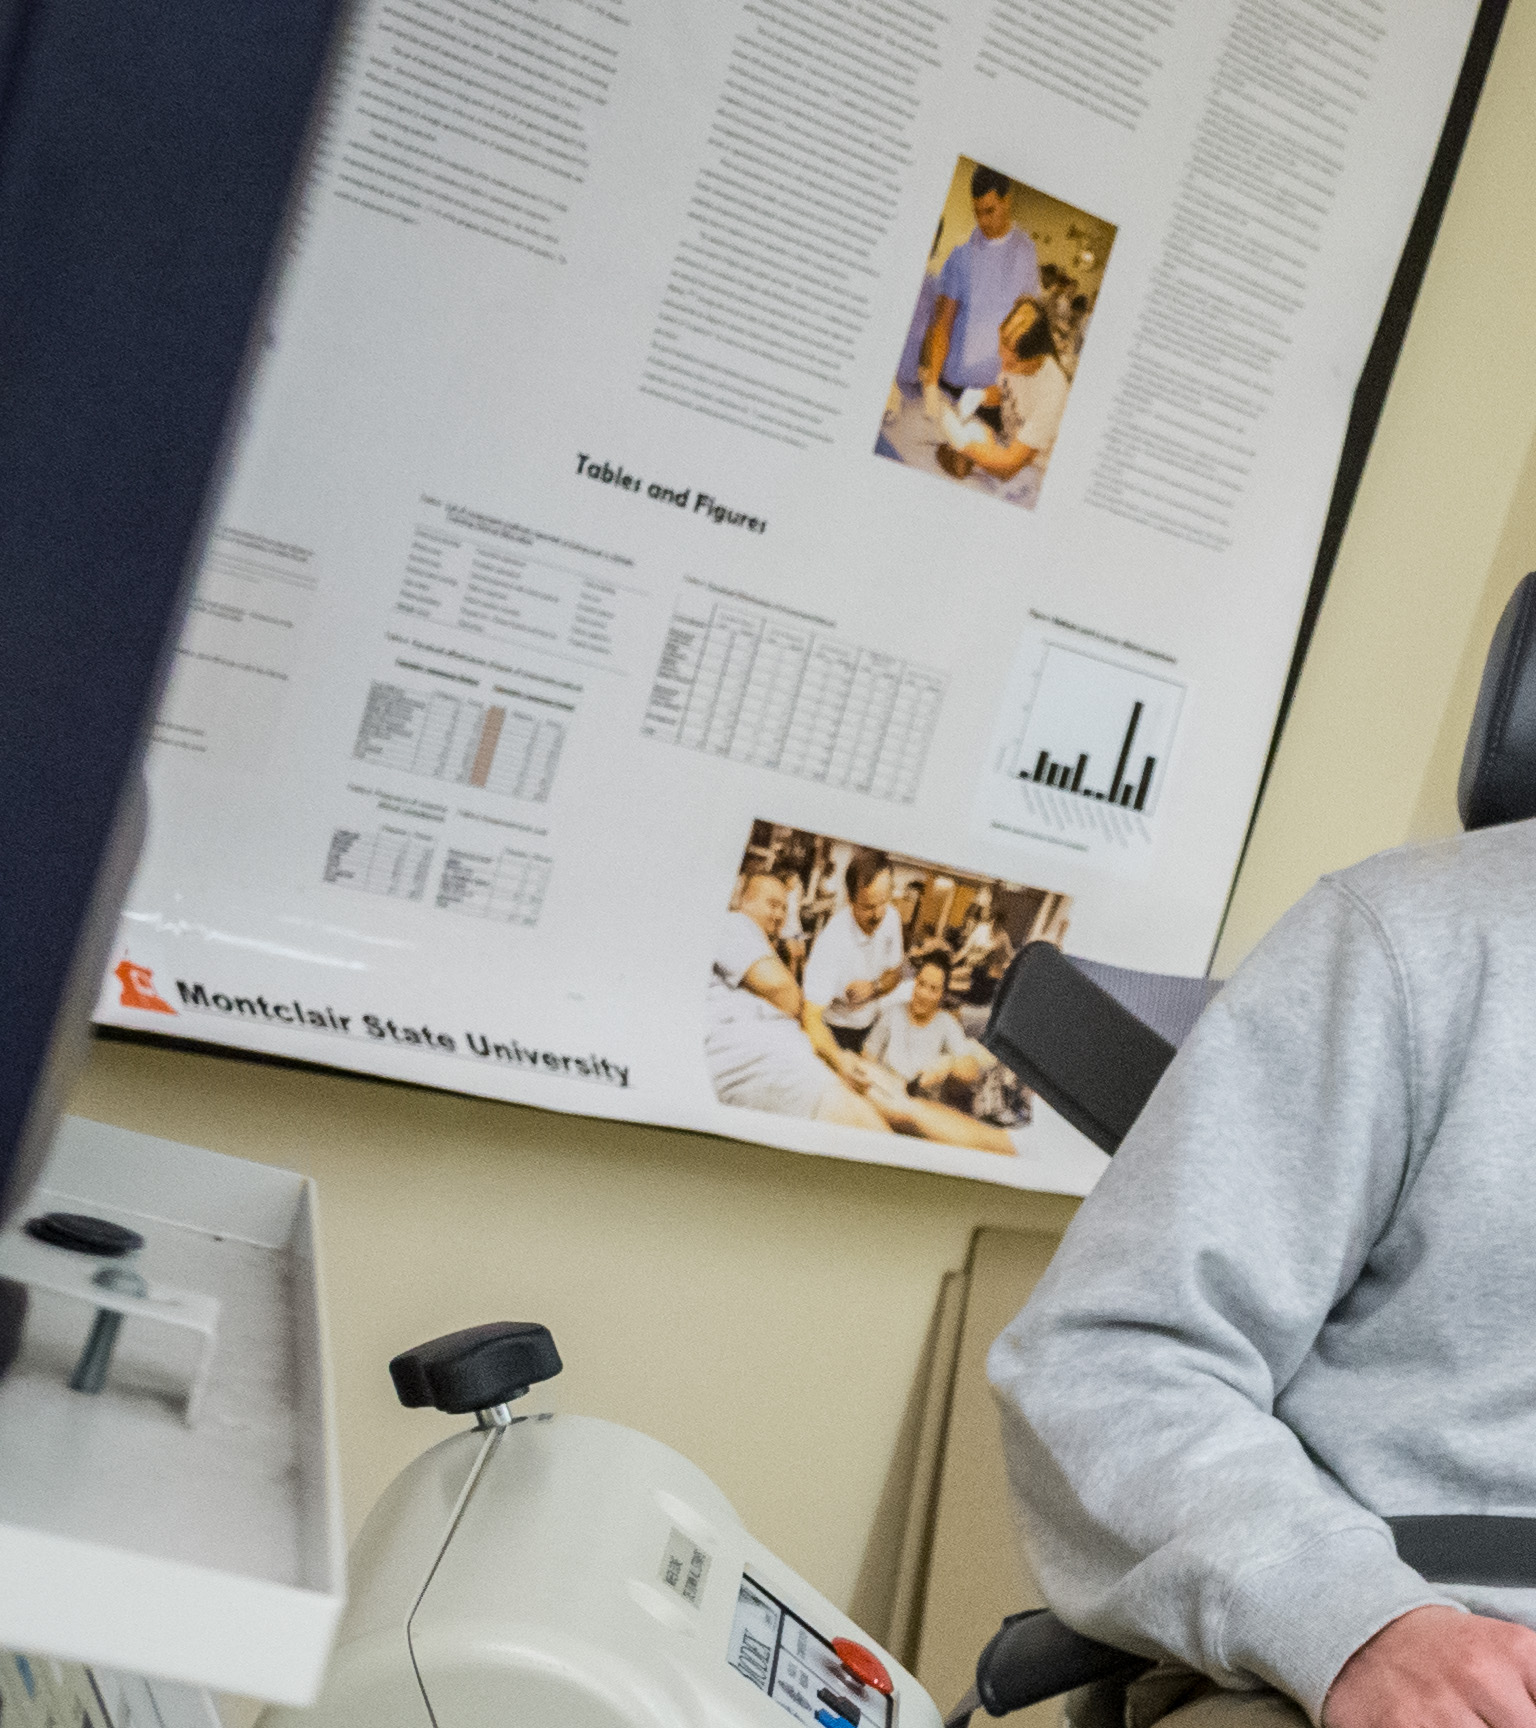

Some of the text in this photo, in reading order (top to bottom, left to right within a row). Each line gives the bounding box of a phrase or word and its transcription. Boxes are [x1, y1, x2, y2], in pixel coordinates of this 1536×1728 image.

[576, 451, 768, 536] Tables and Figures
[175, 978, 631, 1088] Montclair State University
